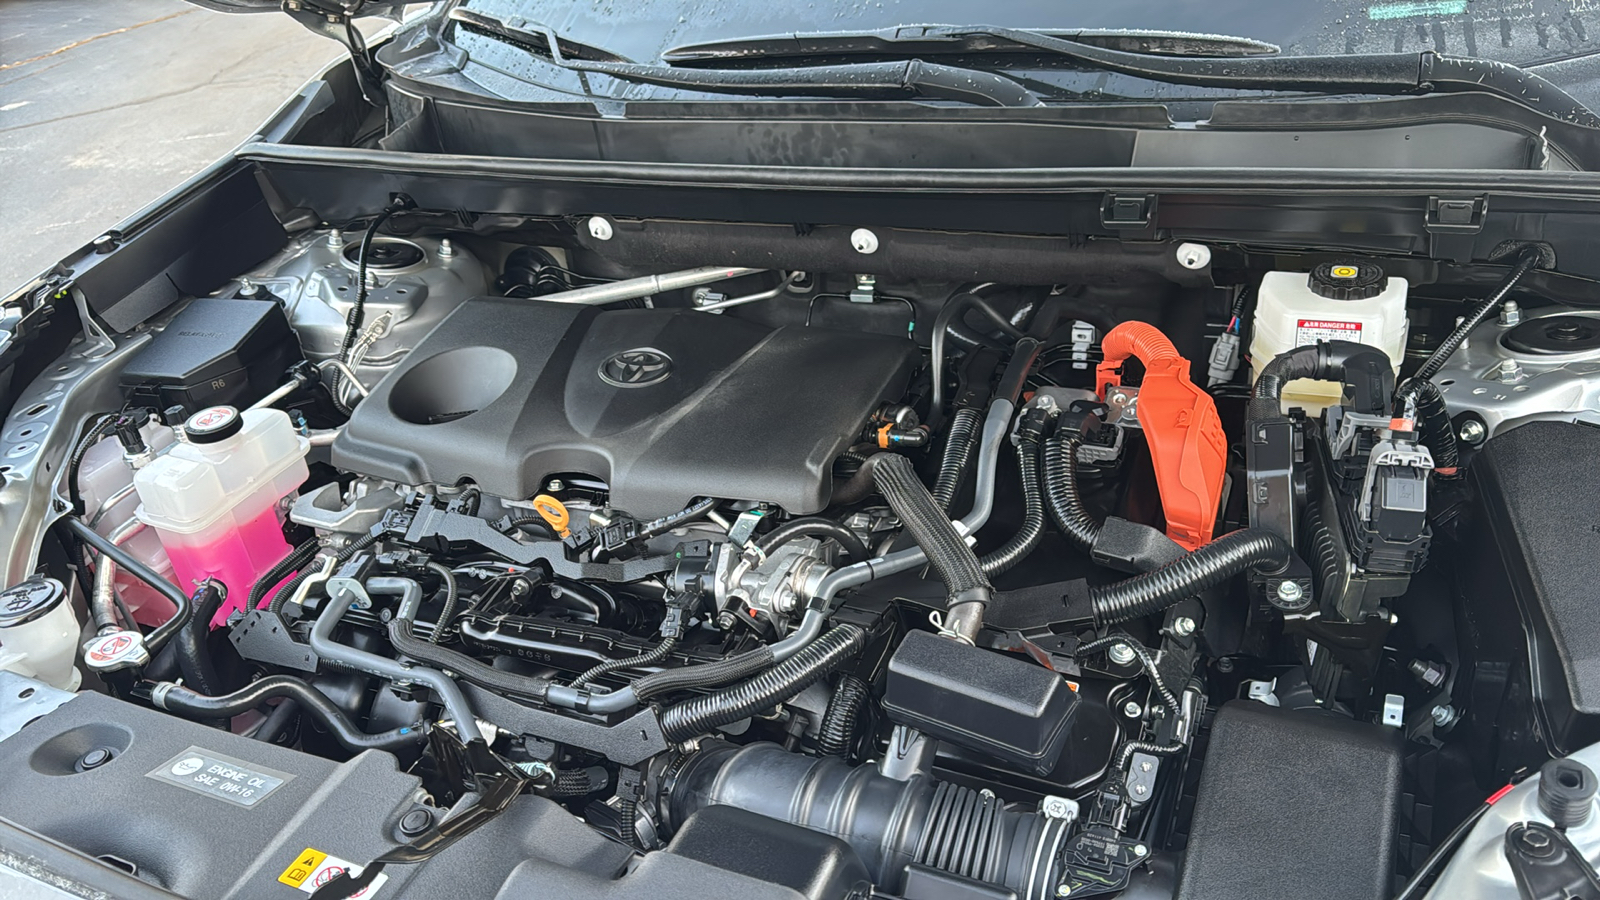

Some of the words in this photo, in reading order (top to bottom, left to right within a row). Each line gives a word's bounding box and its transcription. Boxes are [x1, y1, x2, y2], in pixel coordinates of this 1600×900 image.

[211, 379, 226, 390] R6
[194, 773, 220, 786] SAE
[219, 782, 255, 798] 0W-16
[207, 764, 248, 782] ENGINE
[247, 777, 266, 788] OIL
